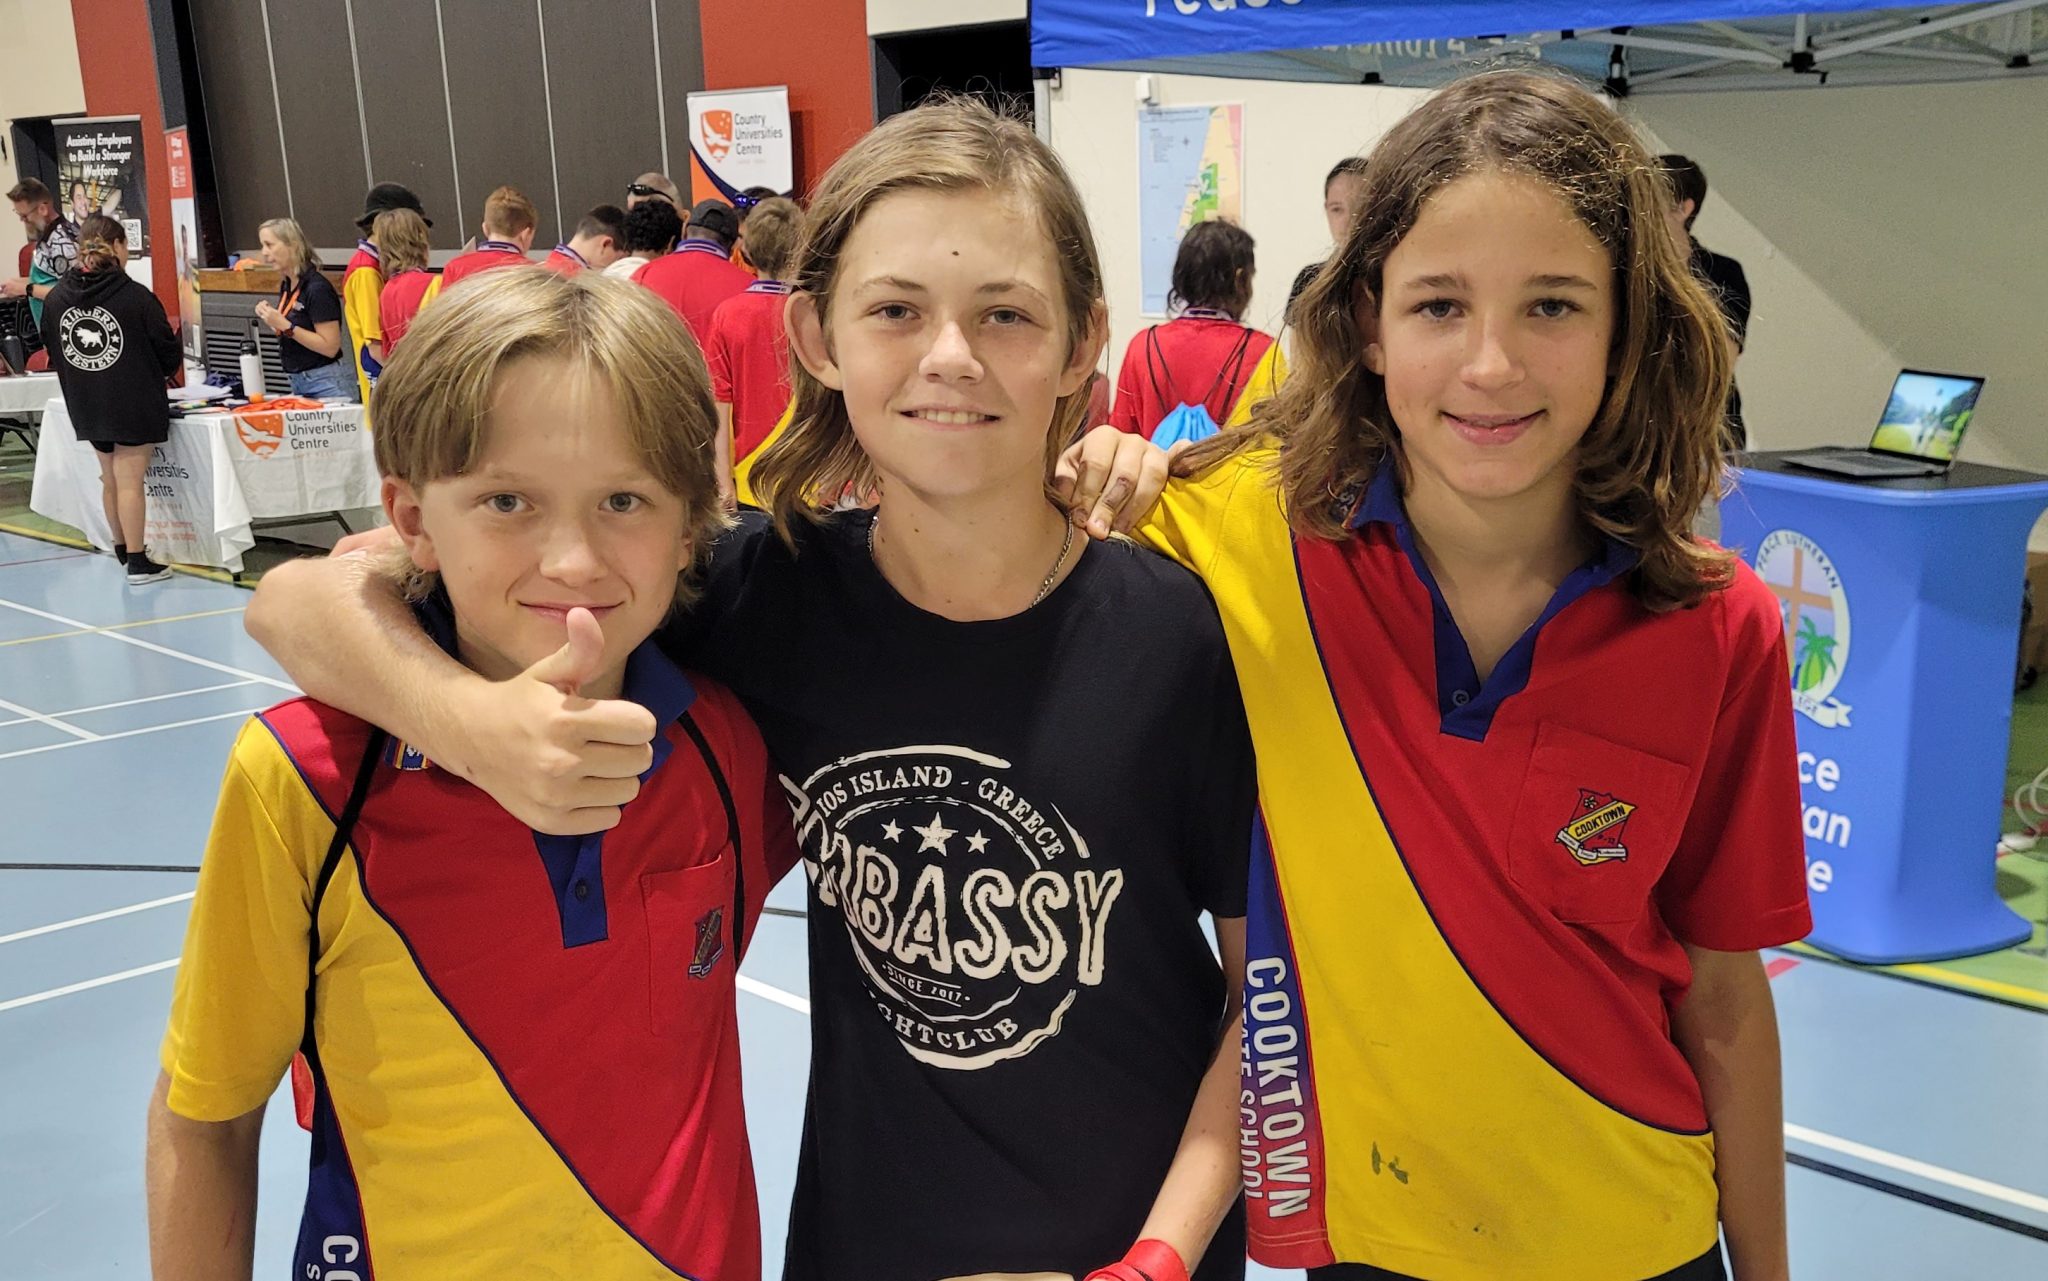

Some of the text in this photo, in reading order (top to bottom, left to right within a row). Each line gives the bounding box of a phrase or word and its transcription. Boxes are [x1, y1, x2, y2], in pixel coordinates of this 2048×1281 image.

[734, 113, 766, 127] Country
[66, 132, 132, 149] Assisting Employers
[735, 126, 783, 140] Universities
[69, 148, 132, 163] to Build a Stronger
[736, 143, 762, 155] Centre
[83, 164, 118, 180] Workforce
[62, 308, 117, 332] RINGERS
[64, 344, 119, 369] WESTERN
[288, 421, 357, 435] Universities
[291, 438, 329, 450] Centre
[816, 781, 848, 818] IOS
[848, 766, 952, 797] ISLAND
[978, 778, 1066, 861] GREECE
[1574, 805, 1626, 838] COOKTOWN
[887, 965, 962, 1002] SINCE 2017
[1246, 956, 1311, 1218] COOKTOWN
